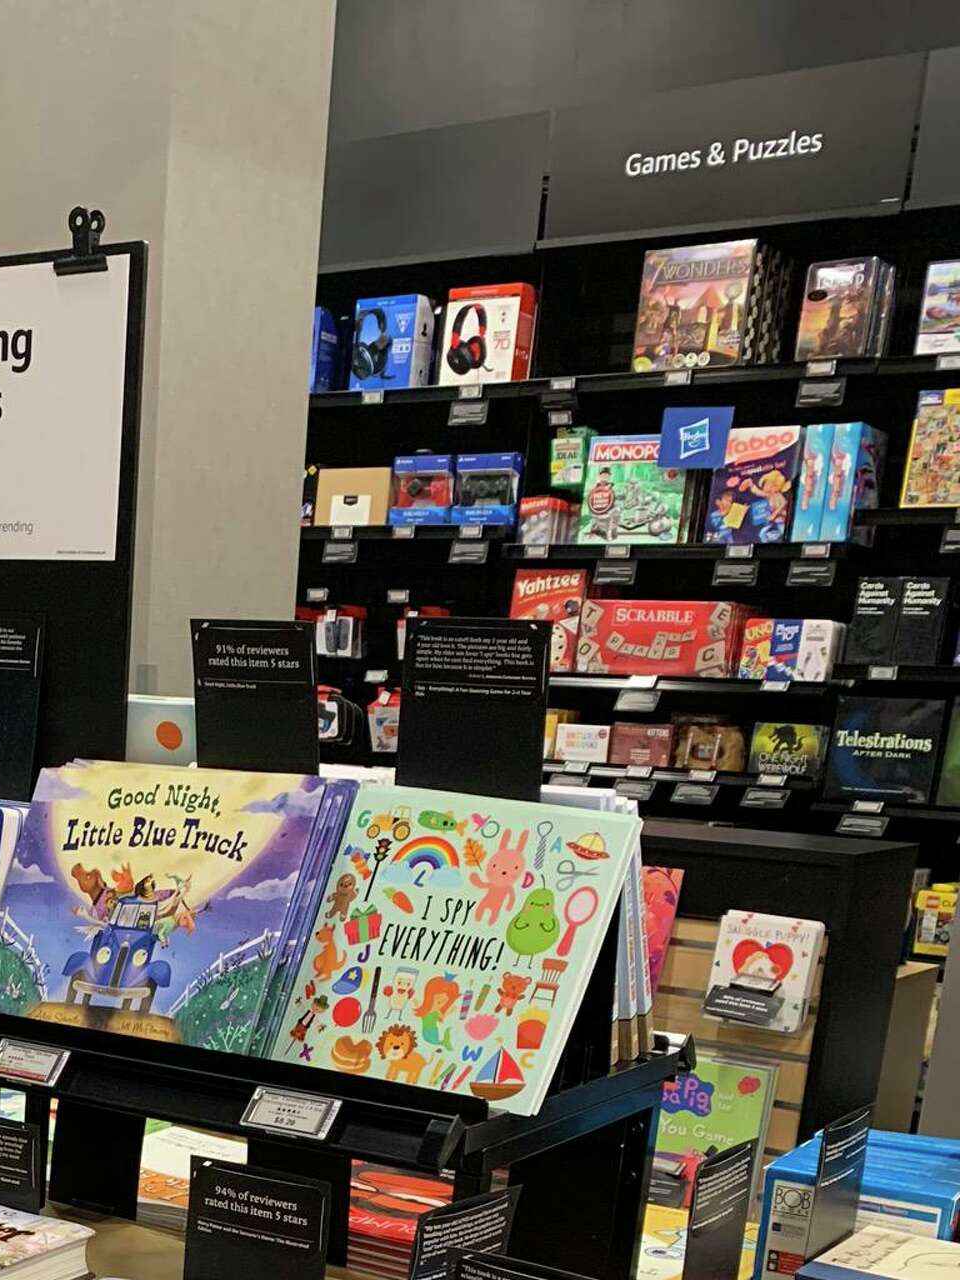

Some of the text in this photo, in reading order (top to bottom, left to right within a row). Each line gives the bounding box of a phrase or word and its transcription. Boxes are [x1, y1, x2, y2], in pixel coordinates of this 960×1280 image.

[625, 130, 823, 176] Games & Puzzles
[664, 259, 751, 281] WONDERS
[517, 572, 582, 598] Yahtzee
[859, 589, 889, 599] Against
[860, 582, 885, 590] Cards
[905, 589, 935, 599] Against
[906, 582, 931, 590] Cards
[858, 597, 896, 606] Humanity
[904, 597, 942, 606] Humanity
[615, 607, 694, 625] SCRABBLE
[744, 622, 773, 641] UNO
[216, 644, 289, 656] 91% of reviewers
[208, 657, 230, 667] rated
[231, 657, 248, 668] this
[248, 658, 269, 669] item
[277, 660, 300, 670] stars
[837, 728, 933, 753] Telestrations
[758, 752, 781, 763] ONE
[852, 750, 911, 759] AFTER DARK
[108, 783, 222, 818] Good Night,
[63, 816, 248, 862] Little Blue Truck
[421, 895, 477, 926] I SPY
[378, 923, 505, 971] EVERYTHING!
[693, 1123, 735, 1145] Game
[215, 1185, 297, 1211] 94% of reviewers
[776, 1187, 810, 1210] BOB
[205, 1197, 308, 1226] rated this item 5 stars
